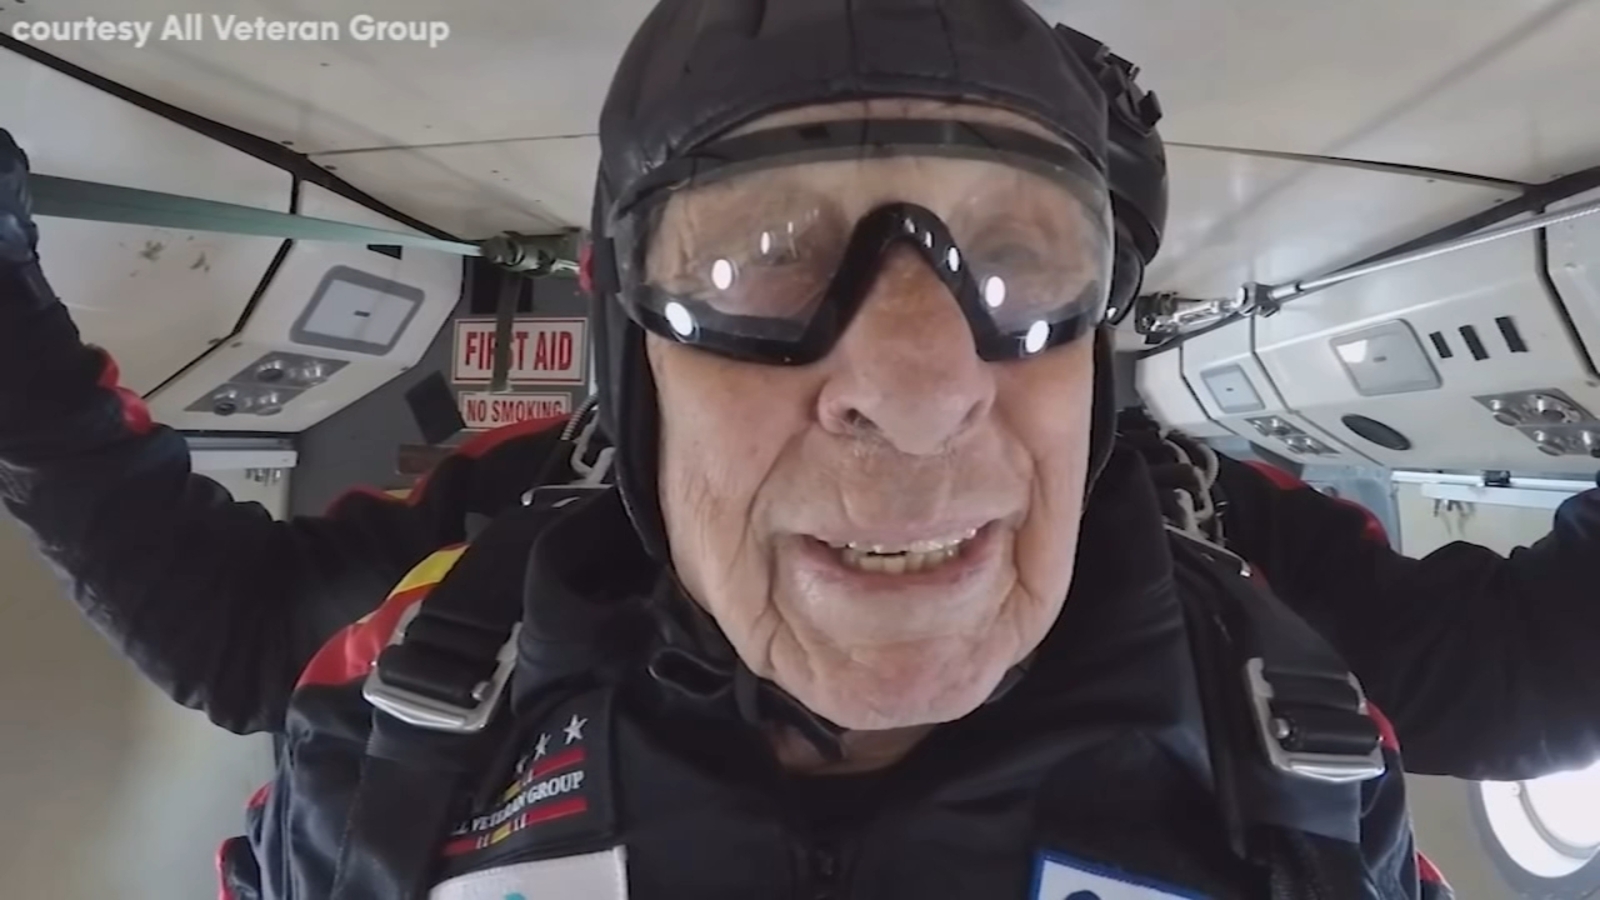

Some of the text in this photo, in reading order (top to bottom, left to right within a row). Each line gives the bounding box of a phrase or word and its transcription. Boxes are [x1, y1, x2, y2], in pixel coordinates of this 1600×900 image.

[465, 331, 573, 371] FIRT AID
[467, 400, 487, 422] NO
[528, 770, 585, 804] GROUP
